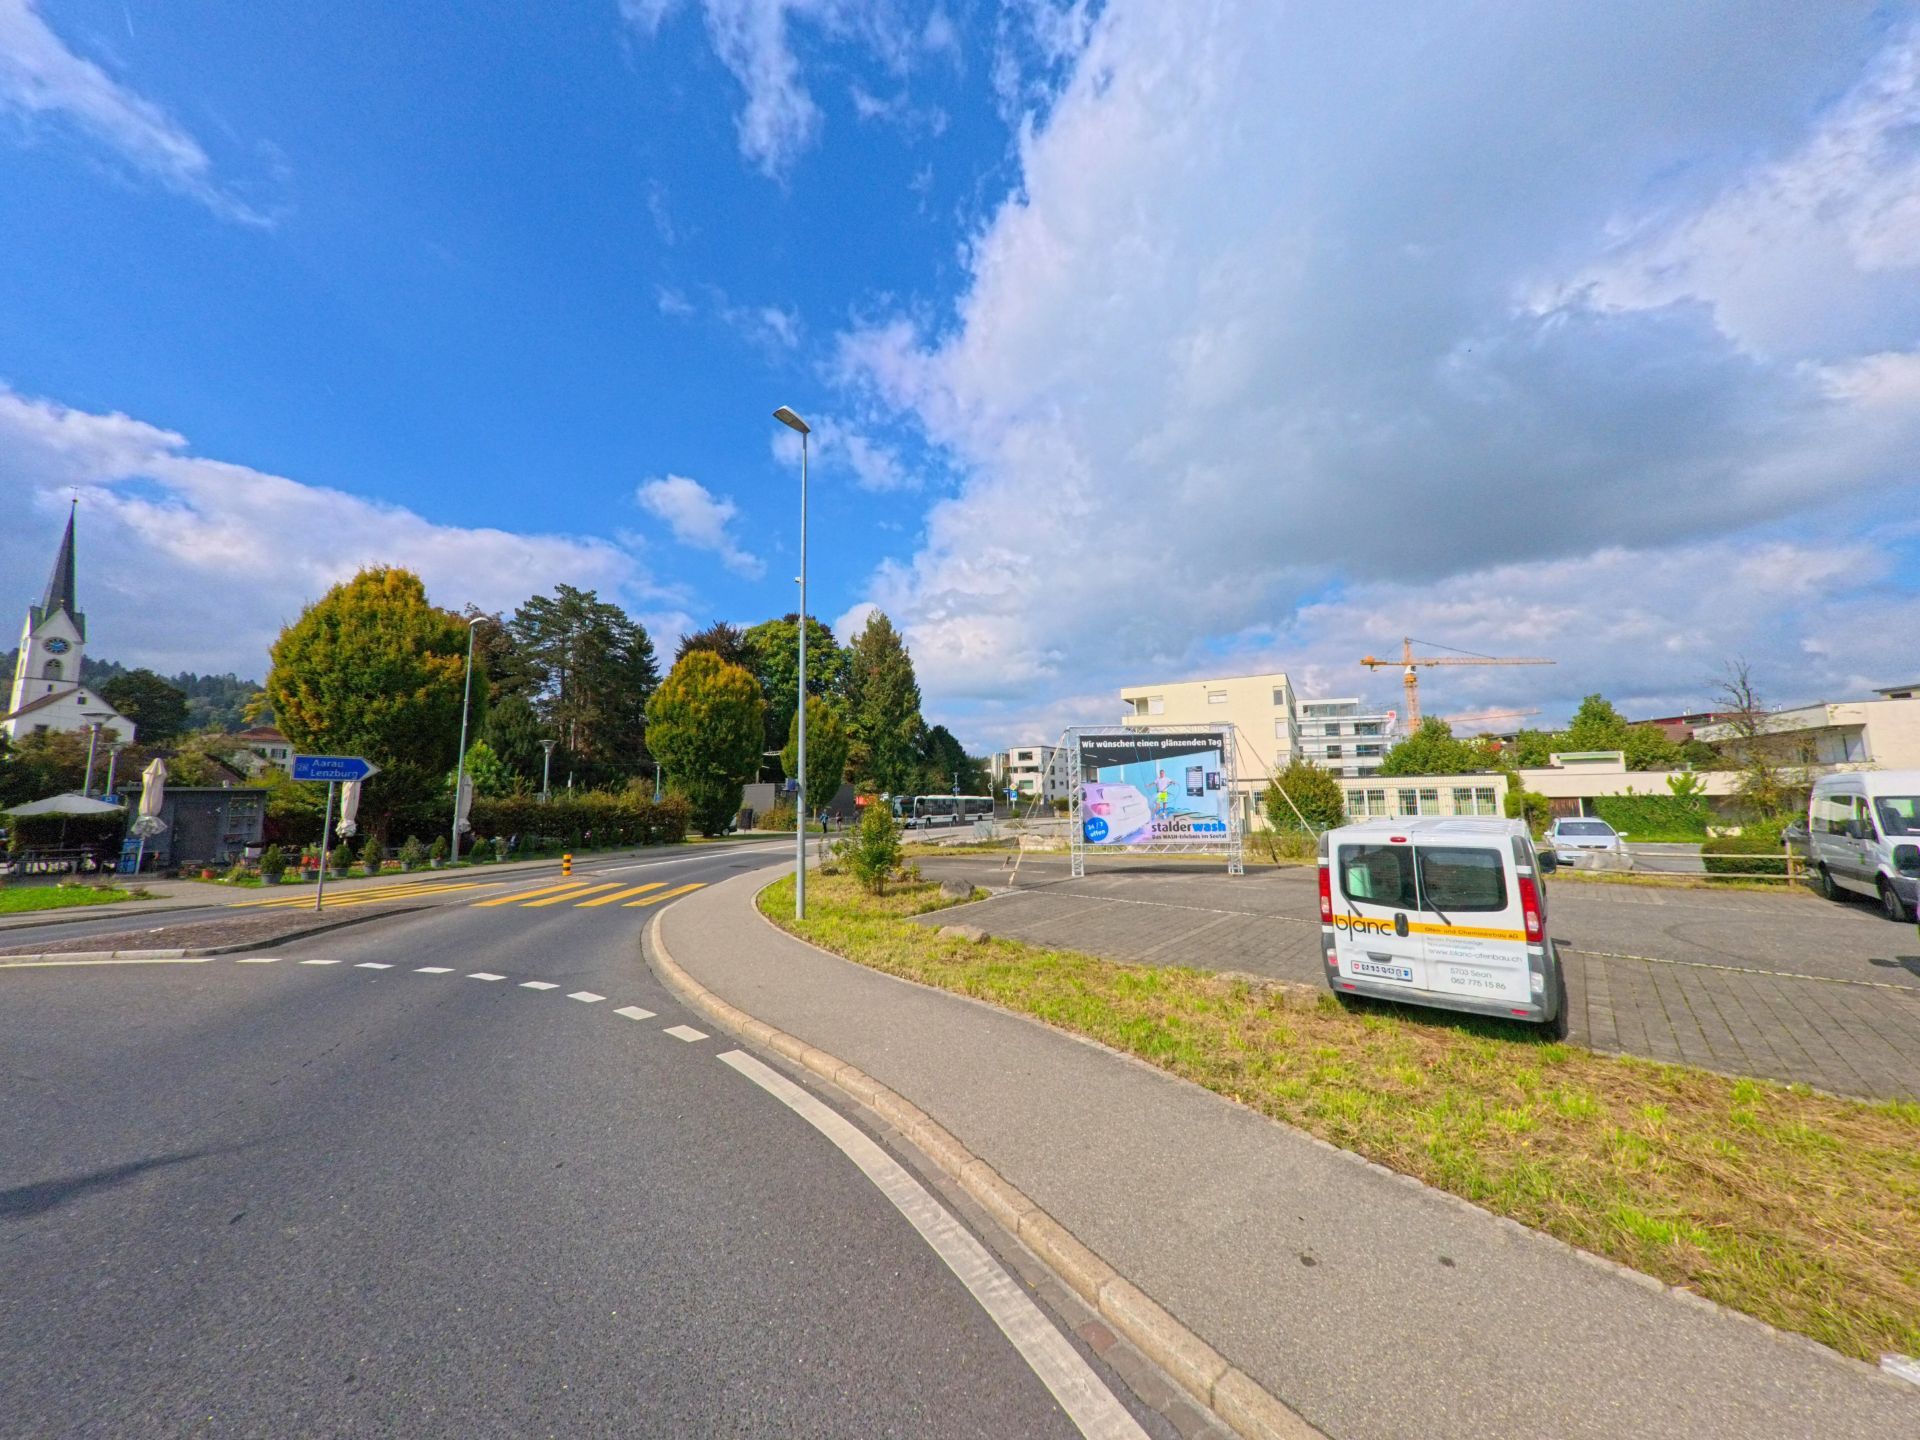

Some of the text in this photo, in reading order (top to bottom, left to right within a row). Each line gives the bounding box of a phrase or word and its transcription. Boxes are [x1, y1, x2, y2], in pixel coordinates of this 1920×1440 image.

[1081, 738, 1222, 749] Wir wünschen einen glänzenden Tag
[312, 759, 344, 768] Aarau
[310, 769, 359, 779] Lenzburg
[1151, 820, 1227, 832] stalderwash
[1334, 910, 1392, 942] blanc
